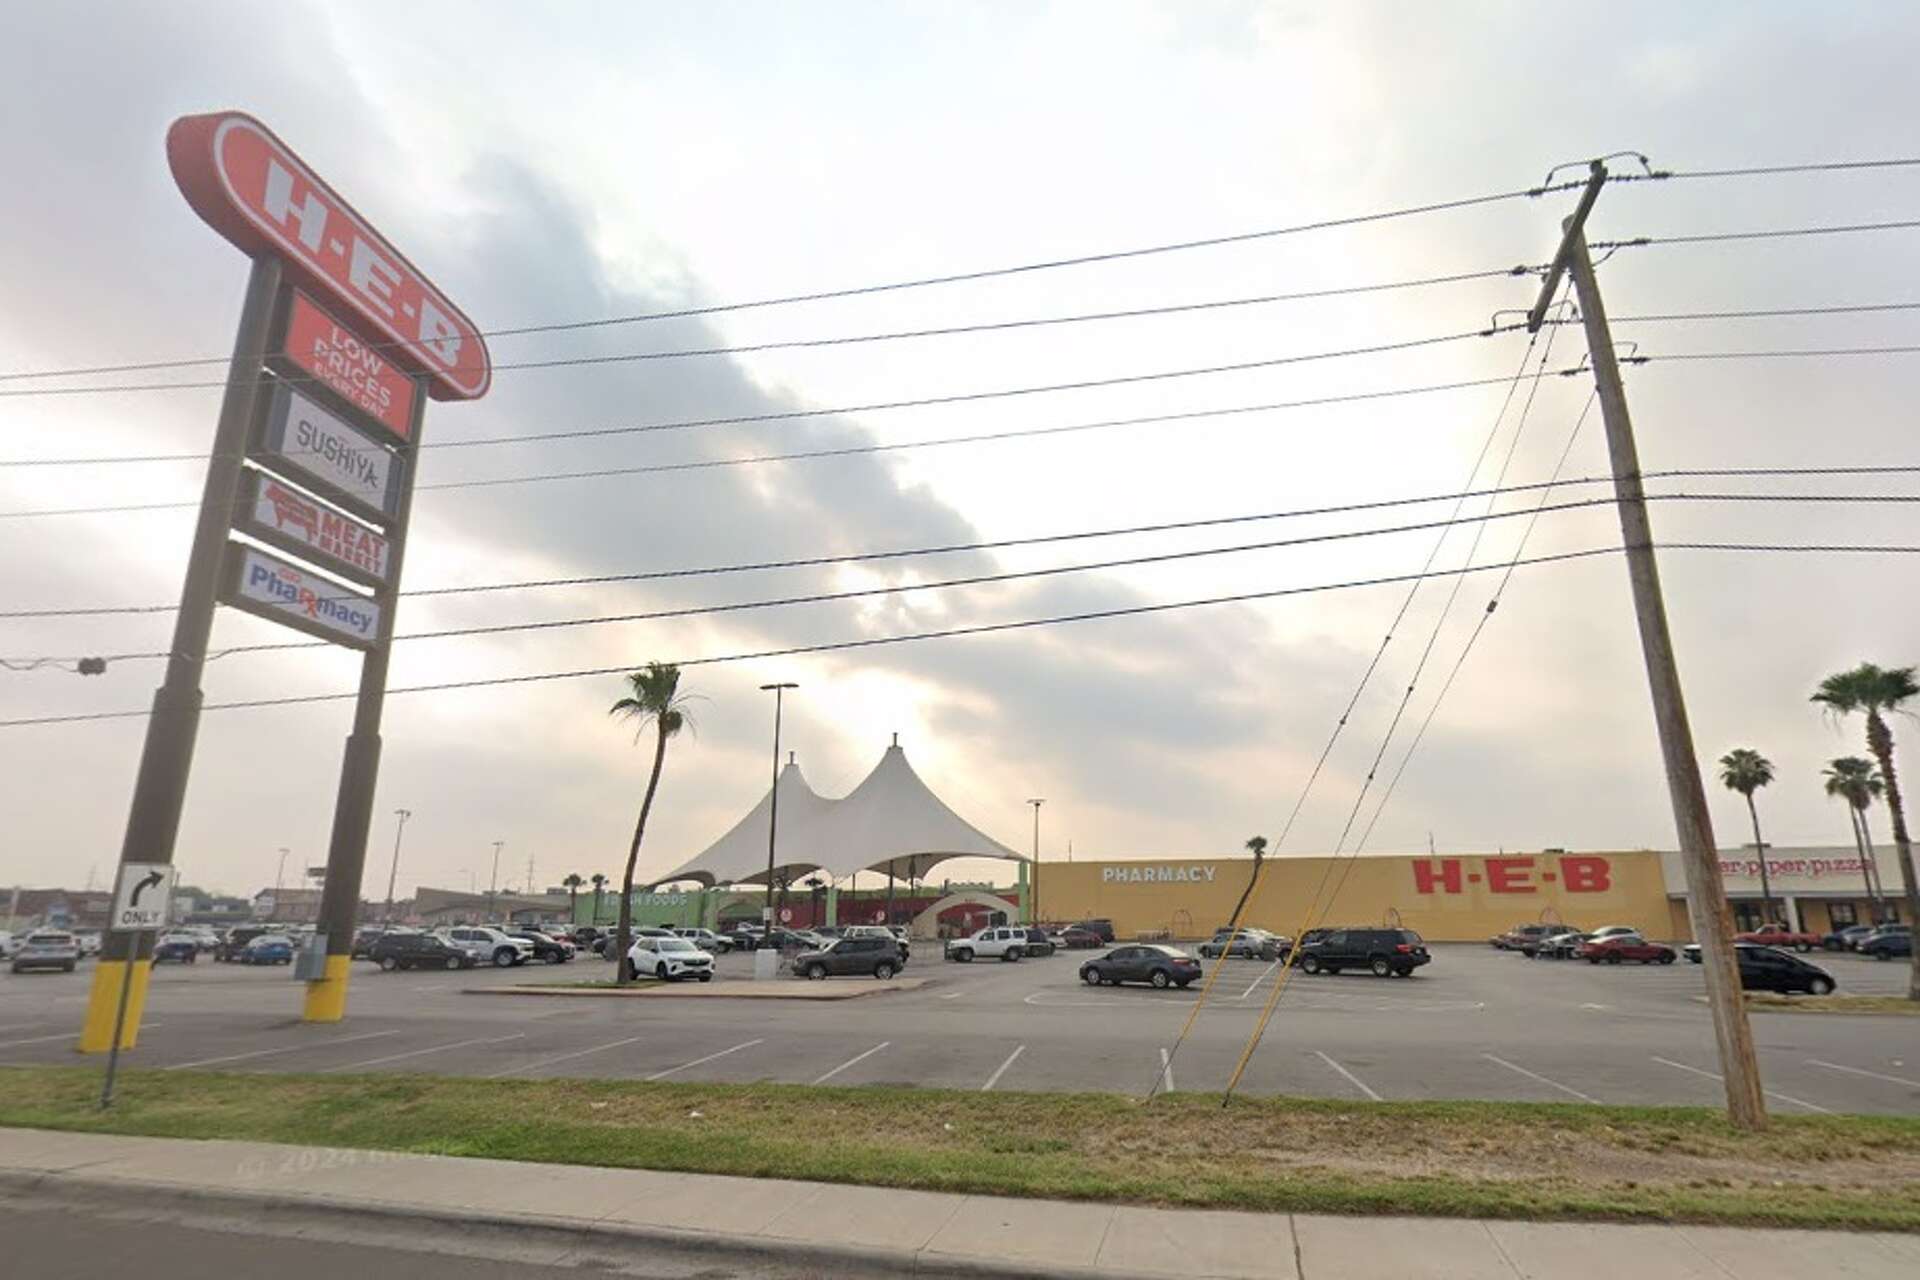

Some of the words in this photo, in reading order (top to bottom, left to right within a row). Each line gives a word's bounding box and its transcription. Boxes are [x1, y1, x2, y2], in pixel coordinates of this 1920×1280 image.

[331, 326, 383, 376] LOW
[313, 337, 391, 407] PRICES
[1102, 864, 1217, 883] PHARMACY
[122, 910, 160, 925] ONLY
